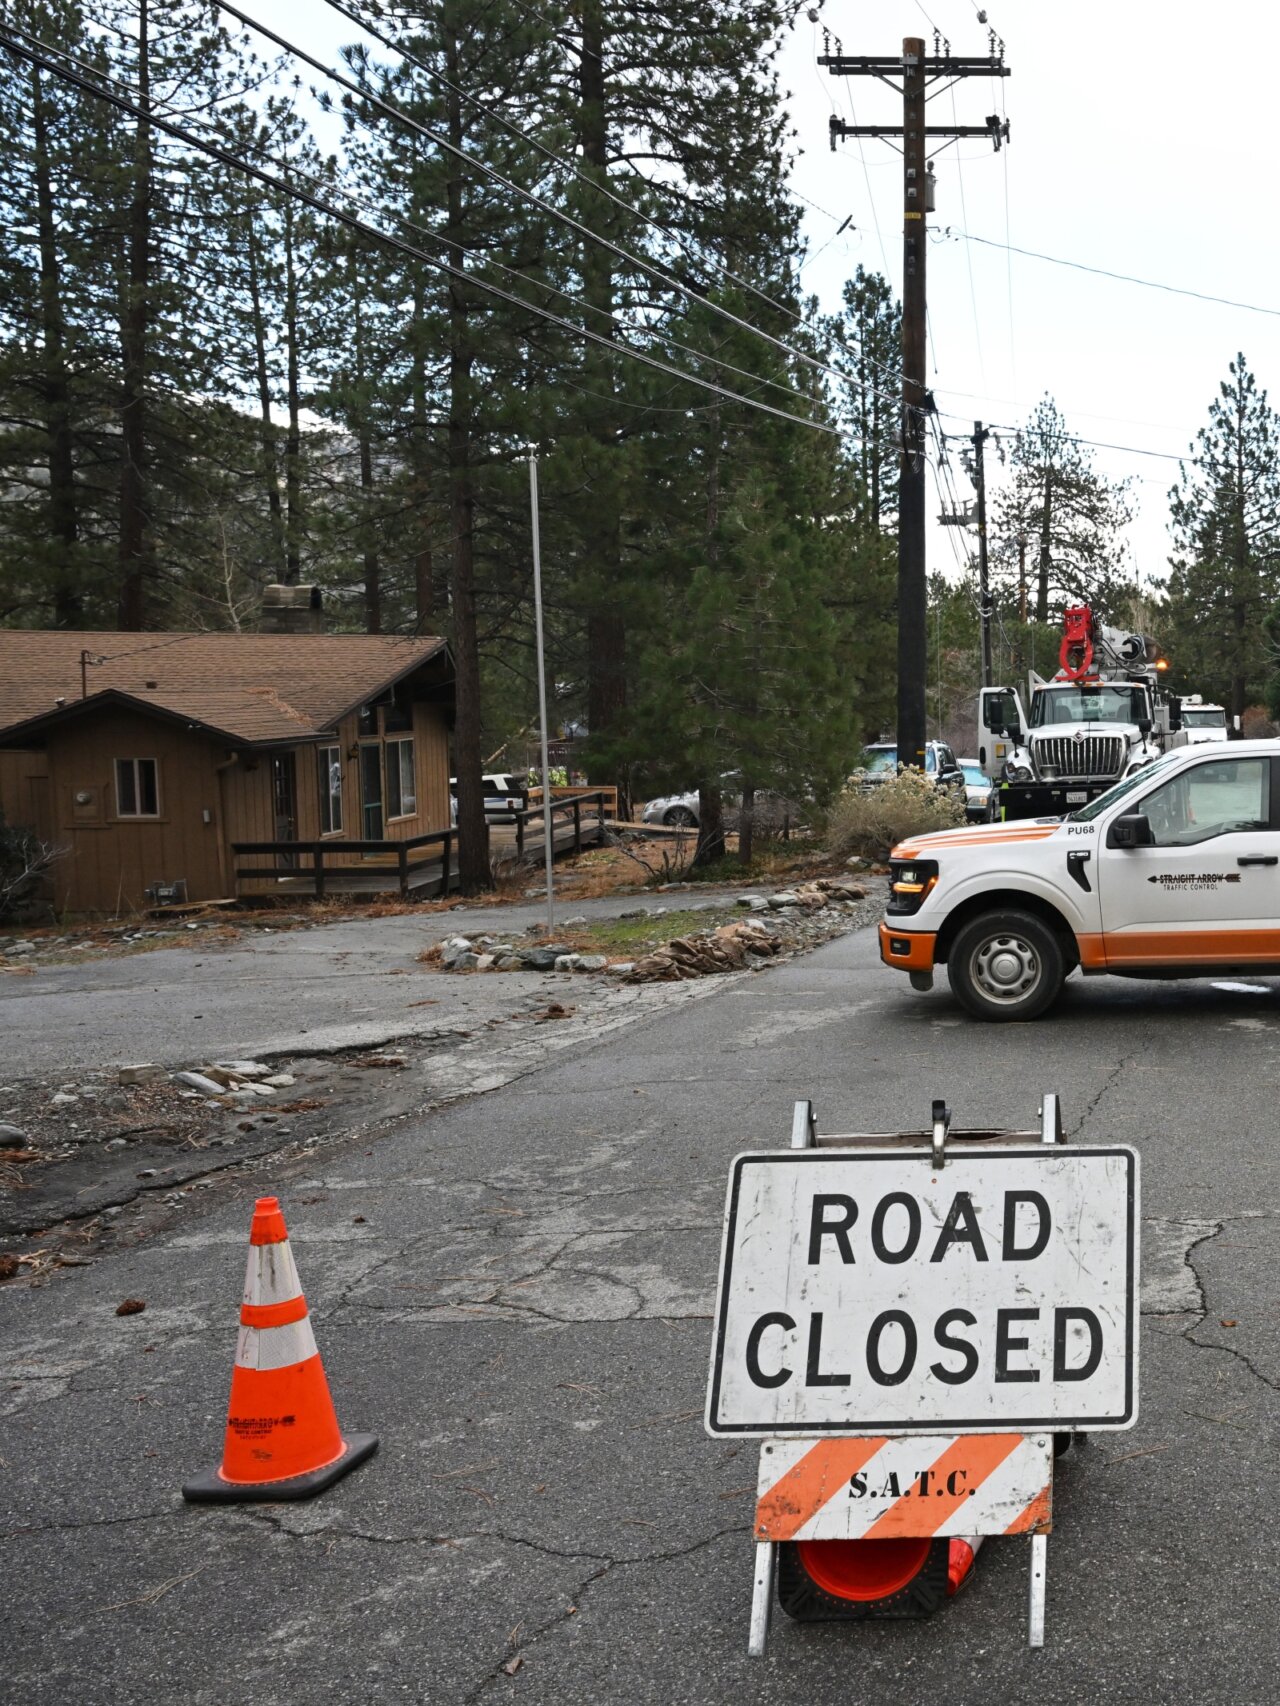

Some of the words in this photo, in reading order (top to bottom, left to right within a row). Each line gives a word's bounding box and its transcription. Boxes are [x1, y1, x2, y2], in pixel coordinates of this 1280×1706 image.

[1068, 825, 1095, 835] PU68
[1160, 873, 1195, 884] STRAIGHT
[1197, 873, 1224, 883] ARROW
[1190, 883, 1218, 891] CONTROL
[807, 1190, 1052, 1265] ROAD
[745, 1306, 1104, 1389] CLOSED
[848, 1470, 976, 1499] S.A.T.C.
